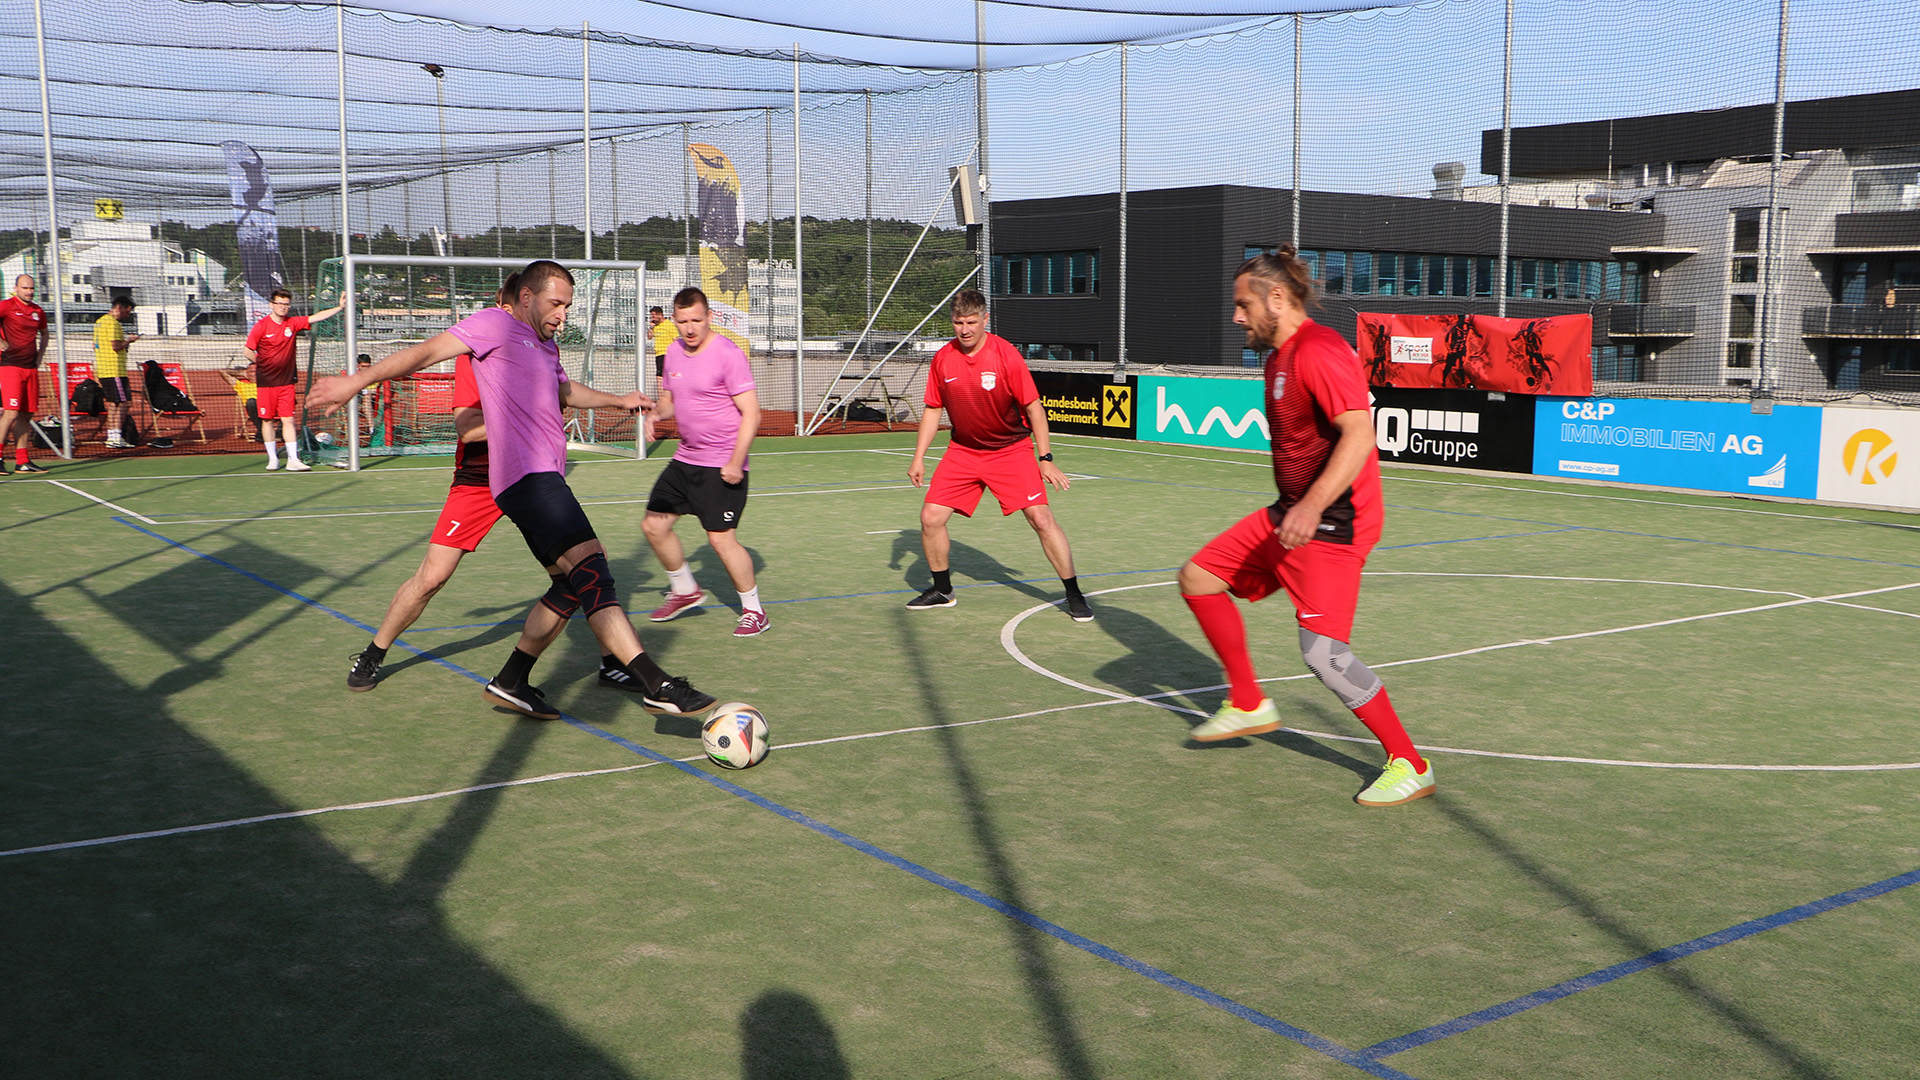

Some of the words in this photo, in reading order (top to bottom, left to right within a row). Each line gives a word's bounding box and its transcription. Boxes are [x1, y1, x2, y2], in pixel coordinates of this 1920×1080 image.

[1404, 344, 1429, 361] sport
[260, 407, 266, 415] 9
[1047, 409, 1099, 425] Steiermark
[1562, 401, 1615, 420] C&P
[1410, 432, 1479, 462] Gruppe
[1561, 423, 1715, 452] IMMOBILIEN
[1721, 434, 1763, 455] AG
[1562, 463, 1616, 474] www.cp-ag.at
[446, 520, 461, 537] 7
